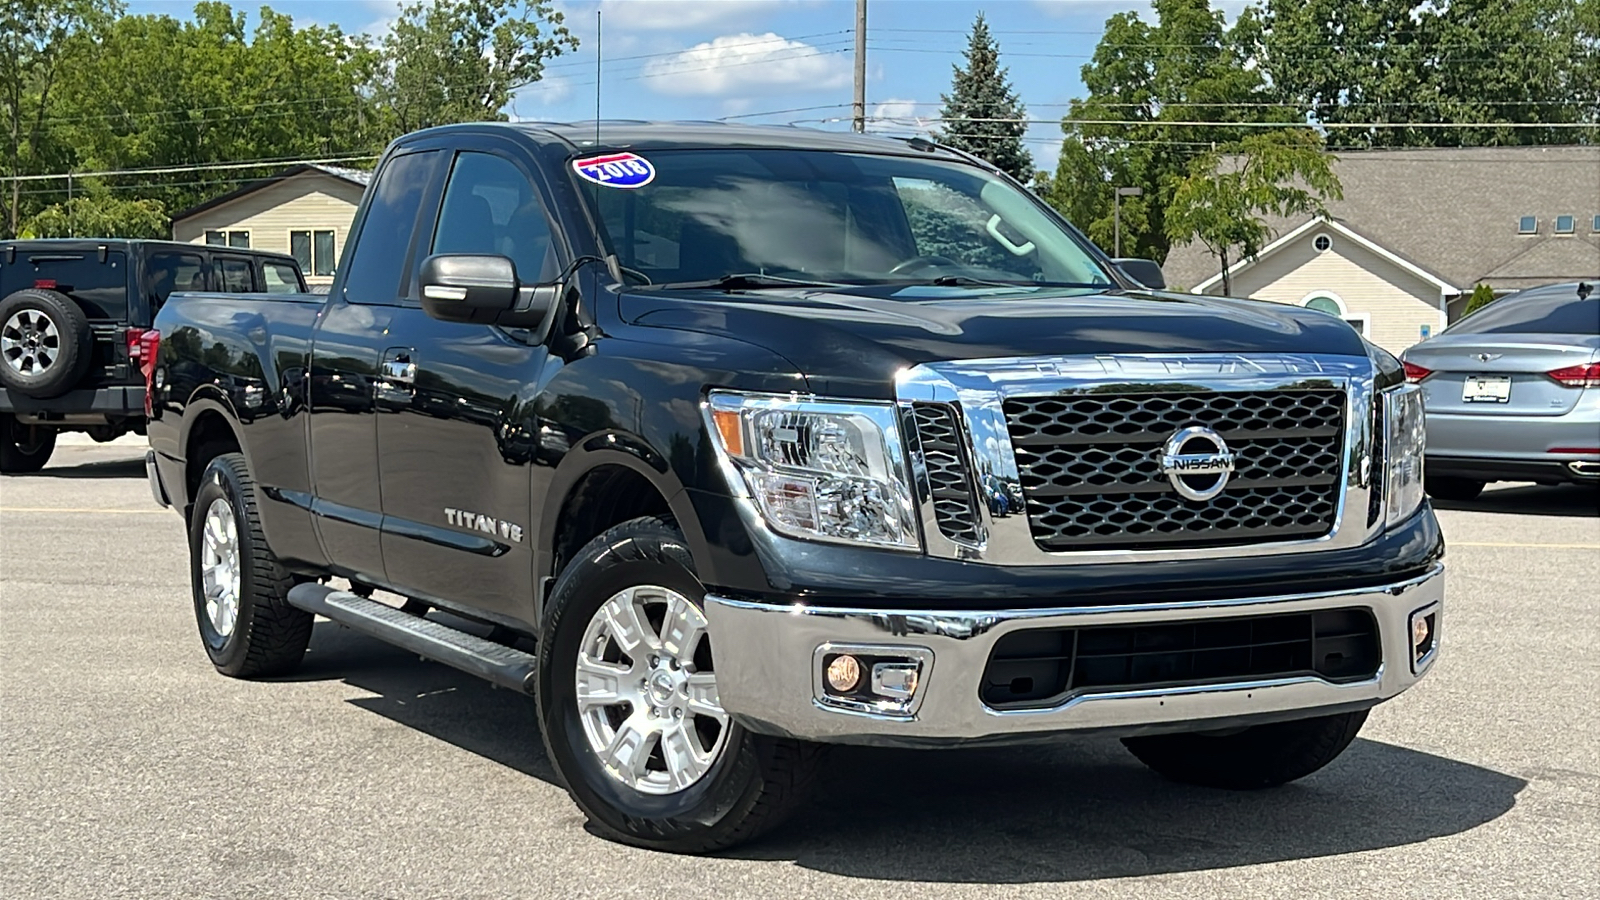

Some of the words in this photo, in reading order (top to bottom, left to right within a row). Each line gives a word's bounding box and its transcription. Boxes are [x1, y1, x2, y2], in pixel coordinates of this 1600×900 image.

[588, 160, 648, 181] 2018
[1173, 457, 1230, 470] NISSAN
[444, 507, 498, 535] TITAN
